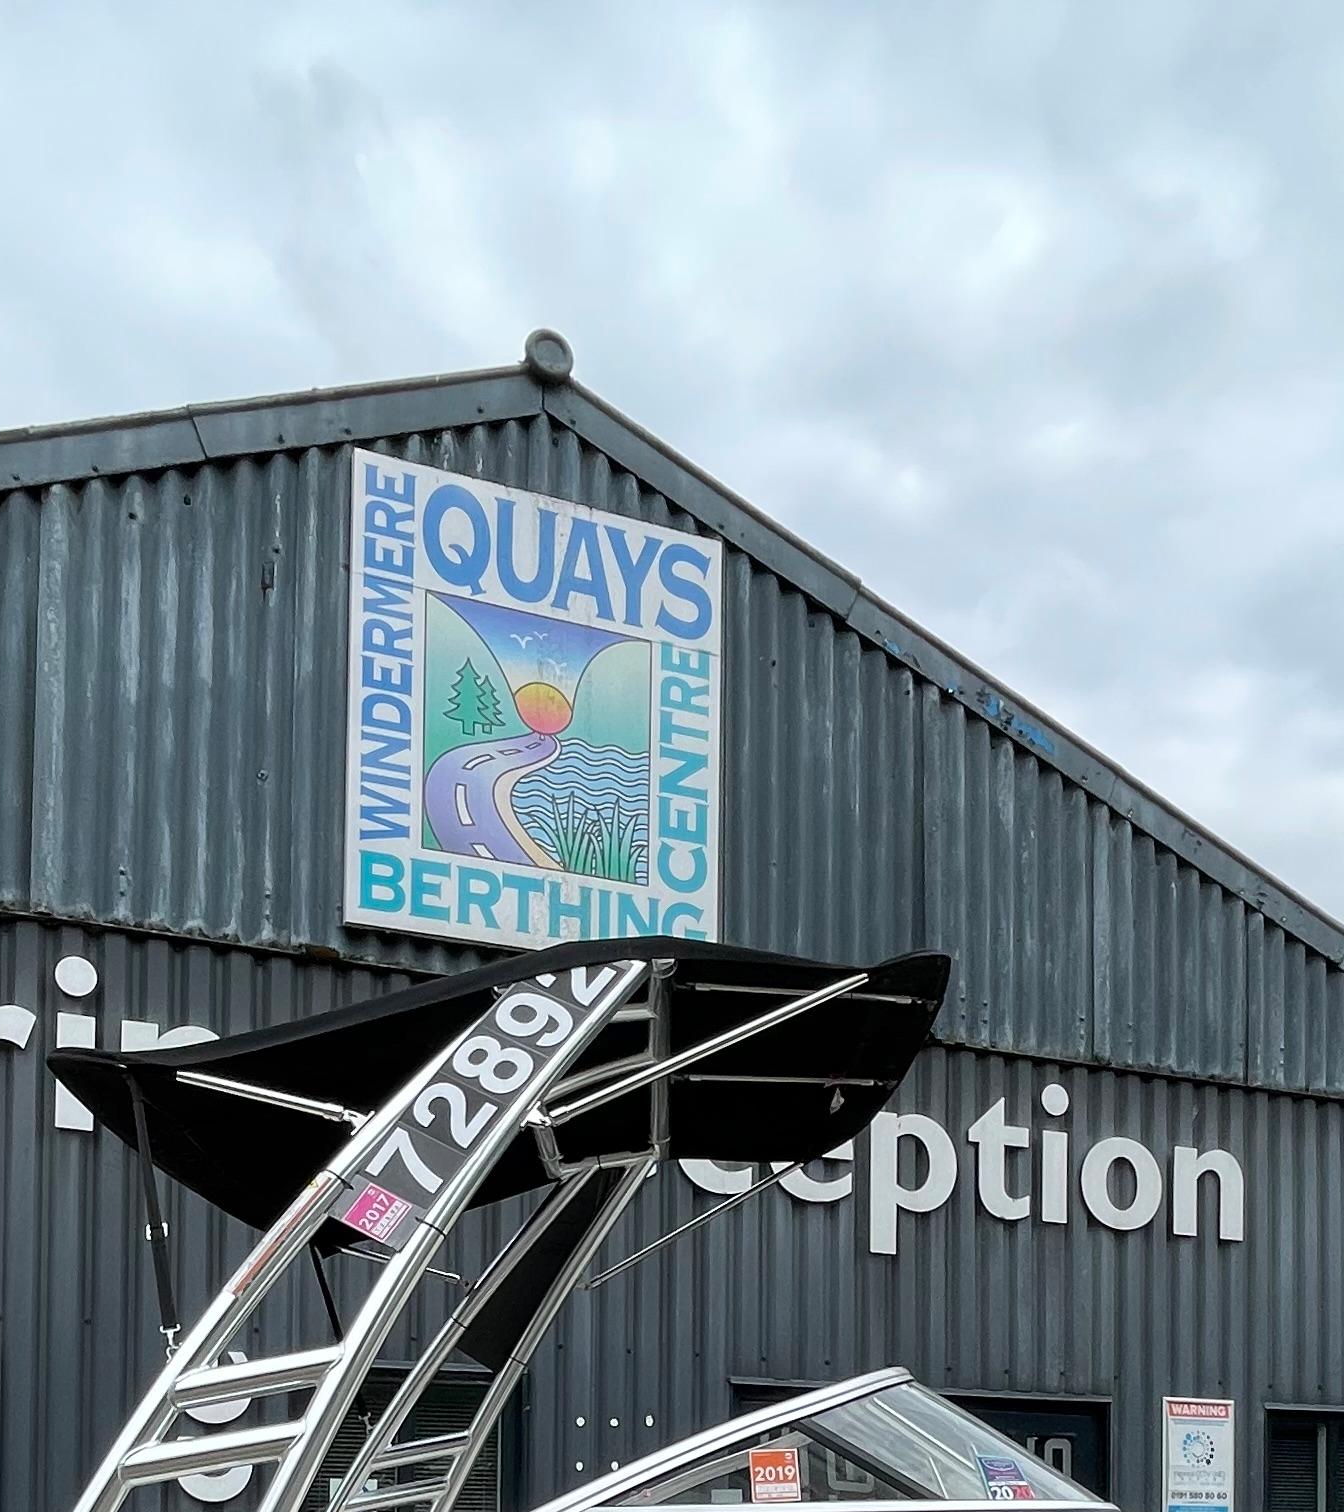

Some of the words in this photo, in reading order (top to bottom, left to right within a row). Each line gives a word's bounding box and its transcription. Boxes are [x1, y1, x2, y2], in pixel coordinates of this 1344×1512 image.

[423, 484, 713, 640] QUAYS
[359, 463, 417, 841] WINDERMERE
[657, 640, 711, 893] CENTRE
[358, 849, 708, 942] BERTHING
[359, 1193, 389, 1231] 2017
[671, 1084, 1244, 1255] ption
[1170, 1403, 1227, 1417] WARNING
[754, 1465, 796, 1482] 2019
